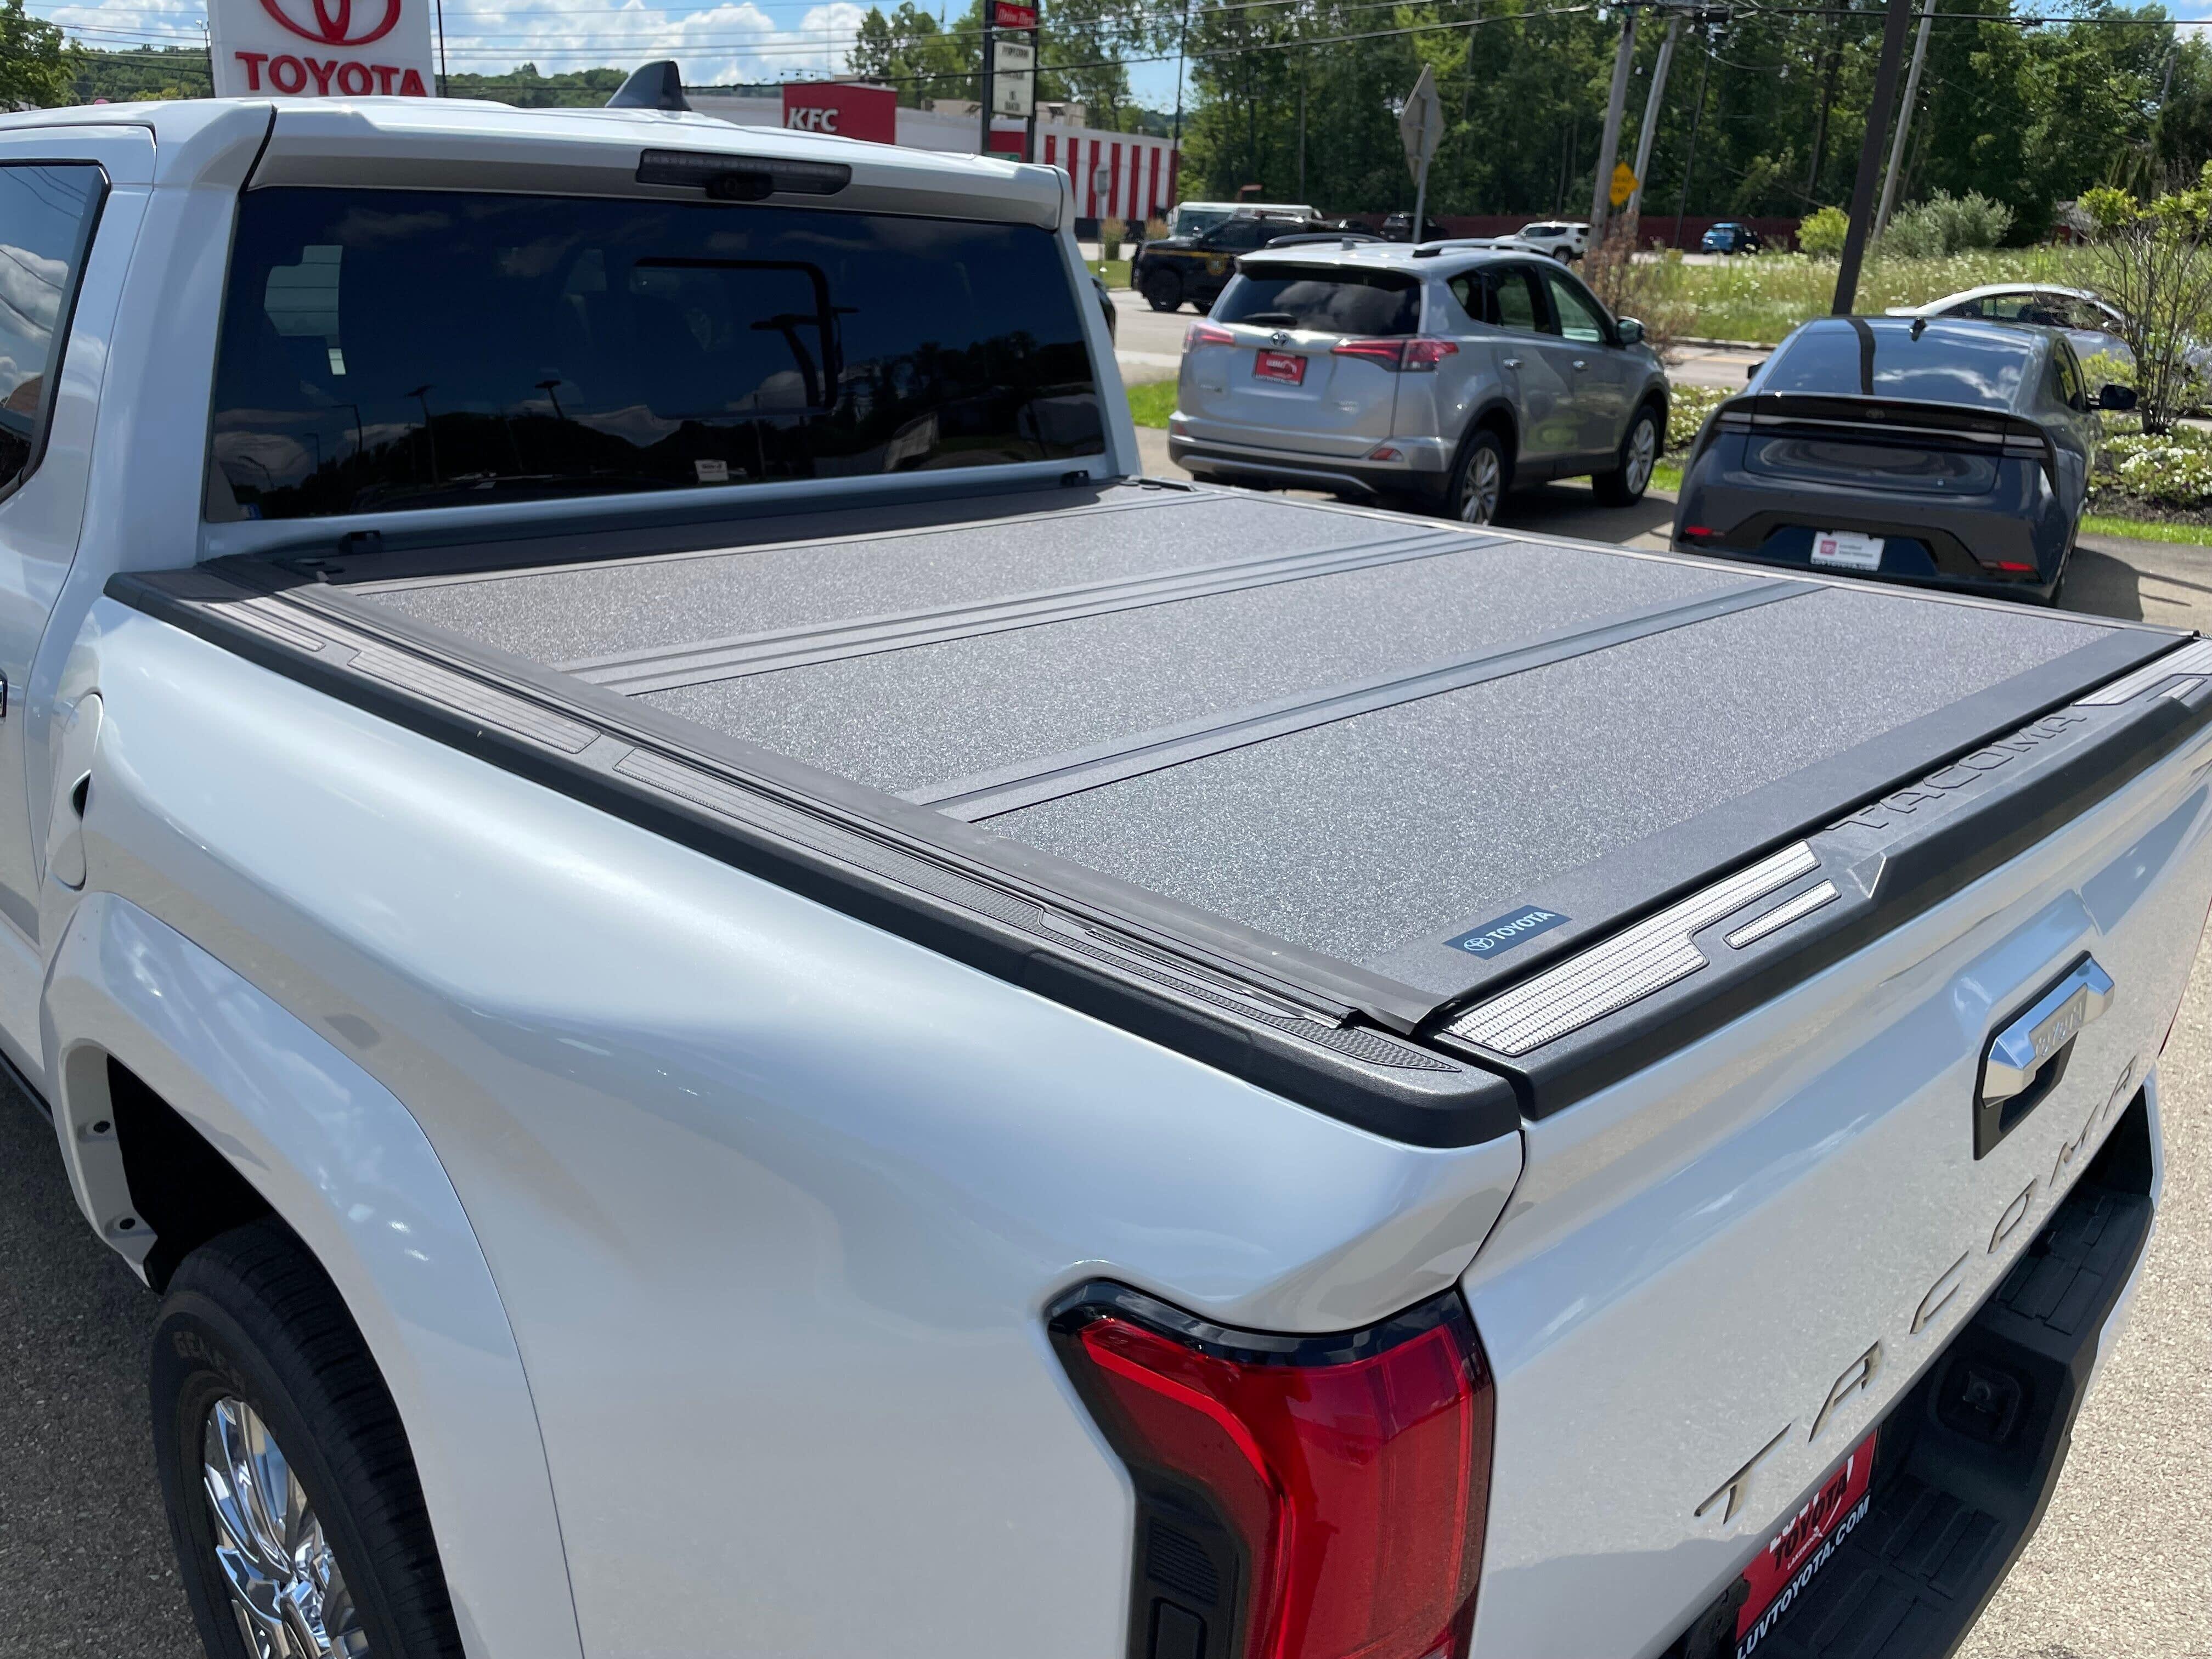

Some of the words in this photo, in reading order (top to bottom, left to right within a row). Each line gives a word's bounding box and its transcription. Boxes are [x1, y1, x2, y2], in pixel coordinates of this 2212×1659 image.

[235, 52, 428, 97] TOYOTA
[786, 106, 839, 132] KFC
[1824, 715, 2087, 831] TACOMA
[1485, 911, 1556, 940] TOYOTA
[1693, 1053, 2138, 1526] TACOMA
[1774, 1471, 1847, 1572] TOYOTA
[1737, 1495, 1870, 1659] LUVTOYOTA.COM
